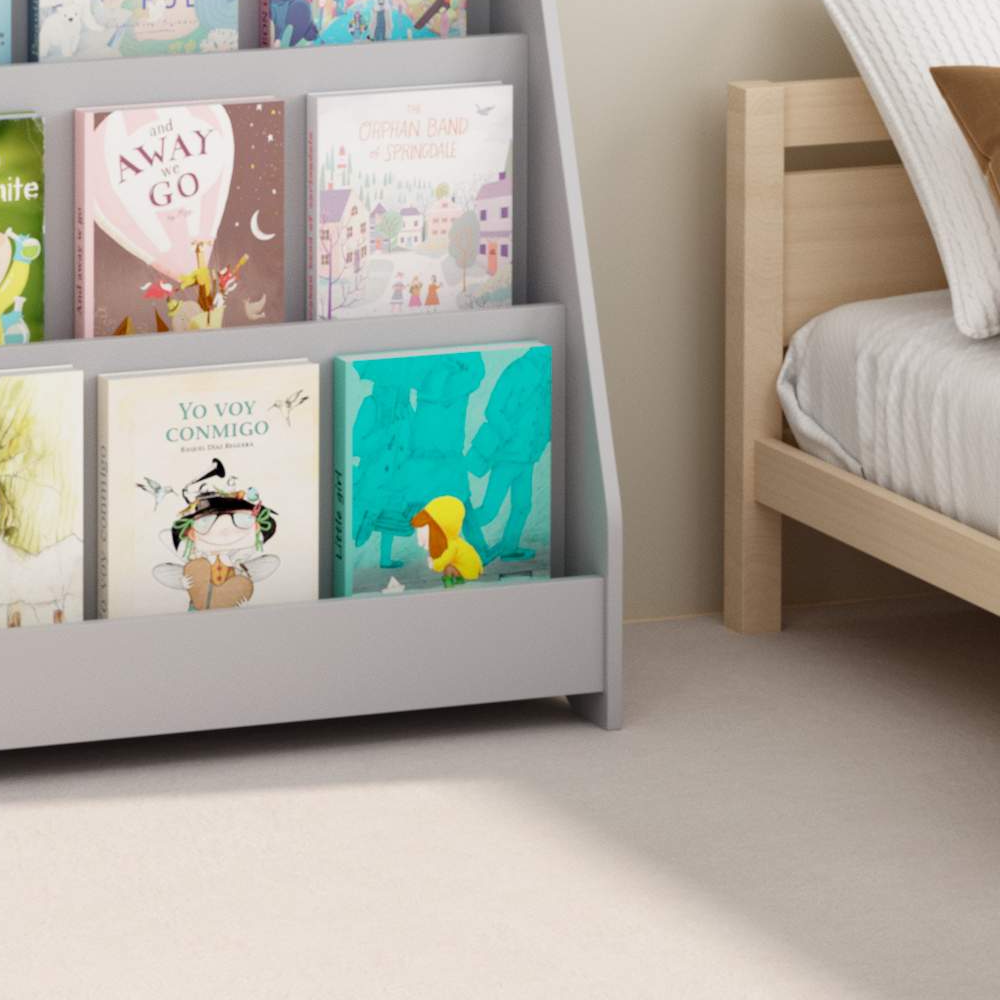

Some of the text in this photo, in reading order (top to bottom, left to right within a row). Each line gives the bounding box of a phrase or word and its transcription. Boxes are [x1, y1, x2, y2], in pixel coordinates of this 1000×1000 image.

[406, 103, 422, 115] THE
[149, 118, 173, 137] and
[358, 116, 470, 142] ORPHAN BAND
[118, 129, 214, 184] AWAY
[369, 140, 458, 162] of SPRINGDALE
[160, 164, 180, 178] we
[149, 172, 199, 207] GO
[215, 400, 256, 417] VOY
[165, 420, 270, 443] CONMIGO
[99, 445, 108, 542] conmigo
[334, 469, 344, 505] girl
